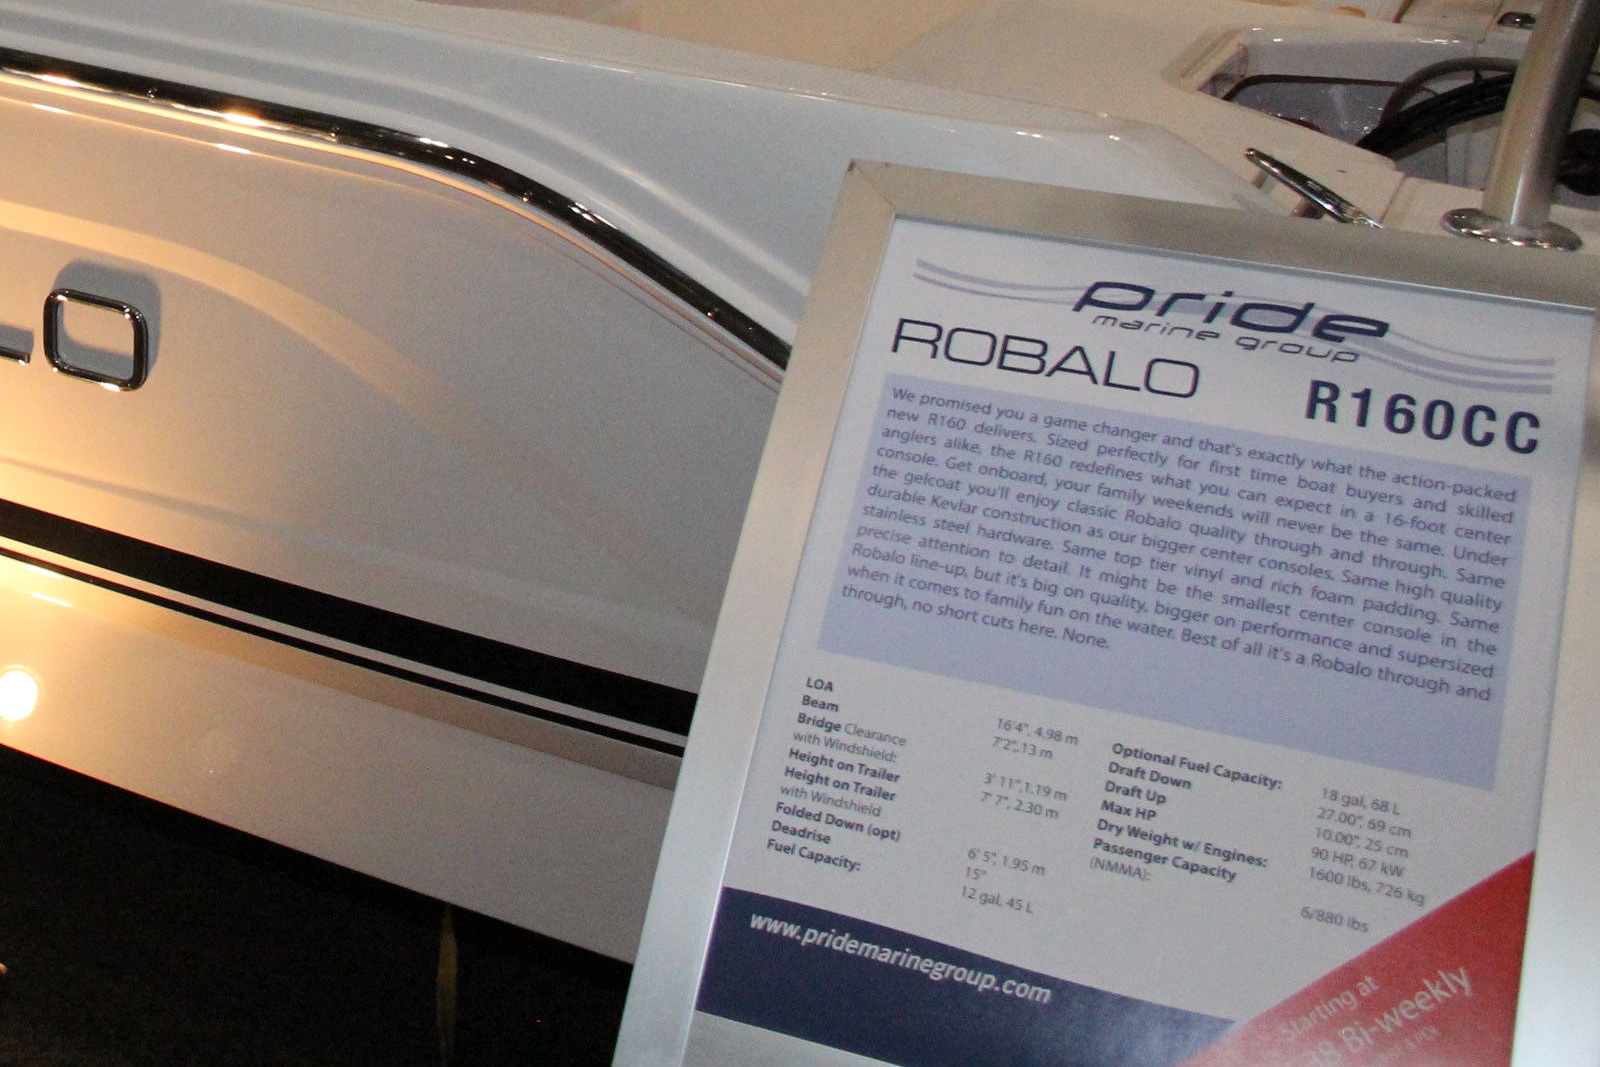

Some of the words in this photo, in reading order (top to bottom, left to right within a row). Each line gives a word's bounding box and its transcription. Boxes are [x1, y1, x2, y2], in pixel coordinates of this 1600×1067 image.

[1071, 280, 1390, 344] pride
[1092, 315, 1221, 341] marine
[1234, 335, 1366, 364] group
[891, 317, 1201, 399] ROBALO
[1305, 379, 1541, 455] R160CC
[892, 387, 916, 402] We
[918, 394, 993, 415] promised
[995, 407, 1025, 421] you
[1029, 413, 1039, 423] a
[1043, 415, 1088, 432] game
[1092, 421, 1158, 444] changer
[1161, 434, 1194, 449] and
[1198, 438, 1243, 457] that's
[1247, 449, 1307, 471] exactly
[1310, 458, 1354, 476] what
[1358, 464, 1388, 482] the
[1391, 473, 1519, 504] action-packed
[944, 456, 973, 473] Get
[1054, 478, 1092, 493] your
[1096, 482, 1146, 506] family
[1152, 496, 1235, 519] weekends
[1241, 510, 1271, 525] will
[1276, 517, 1325, 535] never
[1330, 523, 1354, 541] be
[1359, 529, 1390, 547] the
[1452, 544, 1511, 568] Under
[847, 565, 890, 583] when
[894, 574, 905, 586] it
[908, 578, 959, 597] comes
[964, 587, 981, 601] to
[984, 589, 1034, 614] family
[1037, 599, 1065, 617] fun
[1068, 609, 1090, 623] on
[1095, 612, 1123, 629] the
[1180, 627, 1218, 648] Best
[1220, 636, 1241, 652] of
[1242, 641, 1264, 657] all
[1266, 644, 1292, 663] it's
[1294, 653, 1307, 666] a
[1310, 652, 1374, 679] Robalo
[1377, 666, 1452, 696] through
[1454, 684, 1494, 703] and
[805, 676, 834, 693] LOA
[801, 694, 840, 713] Beam
[793, 732, 821, 746] with
[797, 712, 842, 734] Bridge
[844, 723, 907, 747] Clearance
[1034, 726, 1063, 743] 4.98
[1064, 734, 1079, 746] m
[788, 747, 835, 769] Height
[836, 761, 855, 773] on
[857, 762, 901, 783] Trailer
[1039, 748, 1054, 760] m
[1111, 742, 1177, 767] Optional
[1178, 756, 1211, 774] Fuel
[783, 765, 831, 787] Height
[832, 779, 851, 791] on
[853, 781, 897, 802] Trailer
[1108, 761, 1147, 780] Draft
[1148, 769, 1193, 790] Down
[780, 785, 809, 800] with
[810, 790, 883, 818] Windshield
[1053, 789, 1068, 802] m
[1104, 779, 1144, 800] Draft
[1145, 789, 1167, 806] Up
[1322, 787, 1339, 802] 18
[1370, 798, 1390, 813] 68
[1392, 802, 1400, 816] L
[775, 801, 823, 823] Folded
[824, 812, 865, 833] Down
[866, 823, 901, 843] (opt)
[1013, 798, 1044, 816] 2.30
[1044, 808, 1060, 820] m
[1100, 799, 1132, 817] Max
[1134, 806, 1158, 821] HP
[771, 819, 832, 845] Deadrise
[1097, 818, 1124, 837] Dry
[1126, 824, 1180, 848] Weight
[1366, 817, 1386, 833] 69
[1387, 823, 1412, 839] cm
[766, 838, 797, 856] Fuel
[1093, 837, 1169, 865] Passenger
[1171, 855, 1237, 884] Capacity
[1311, 846, 1330, 861] 90
[1358, 857, 1378, 872] 67
[1380, 861, 1406, 878] kW
[1363, 837, 1383, 853] 25
[1385, 845, 1410, 859] cm
[1001, 855, 1029, 872] 1.95
[1031, 863, 1046, 876] m
[962, 885, 977, 900] 12
[1005, 897, 1023, 912] 45
[1025, 901, 1033, 915] L
[1310, 866, 1345, 886] 1600
[1376, 881, 1404, 900] 726
[1406, 888, 1426, 908] kg
[1300, 906, 1345, 927] 6/880
[1346, 916, 1369, 933] lbs
[750, 913, 1053, 1005] www.pridemarinegroup.com
[1277, 989, 1359, 1041] Starting
[1356, 974, 1381, 997] at
[1337, 966, 1473, 1054] Bi-weekly
